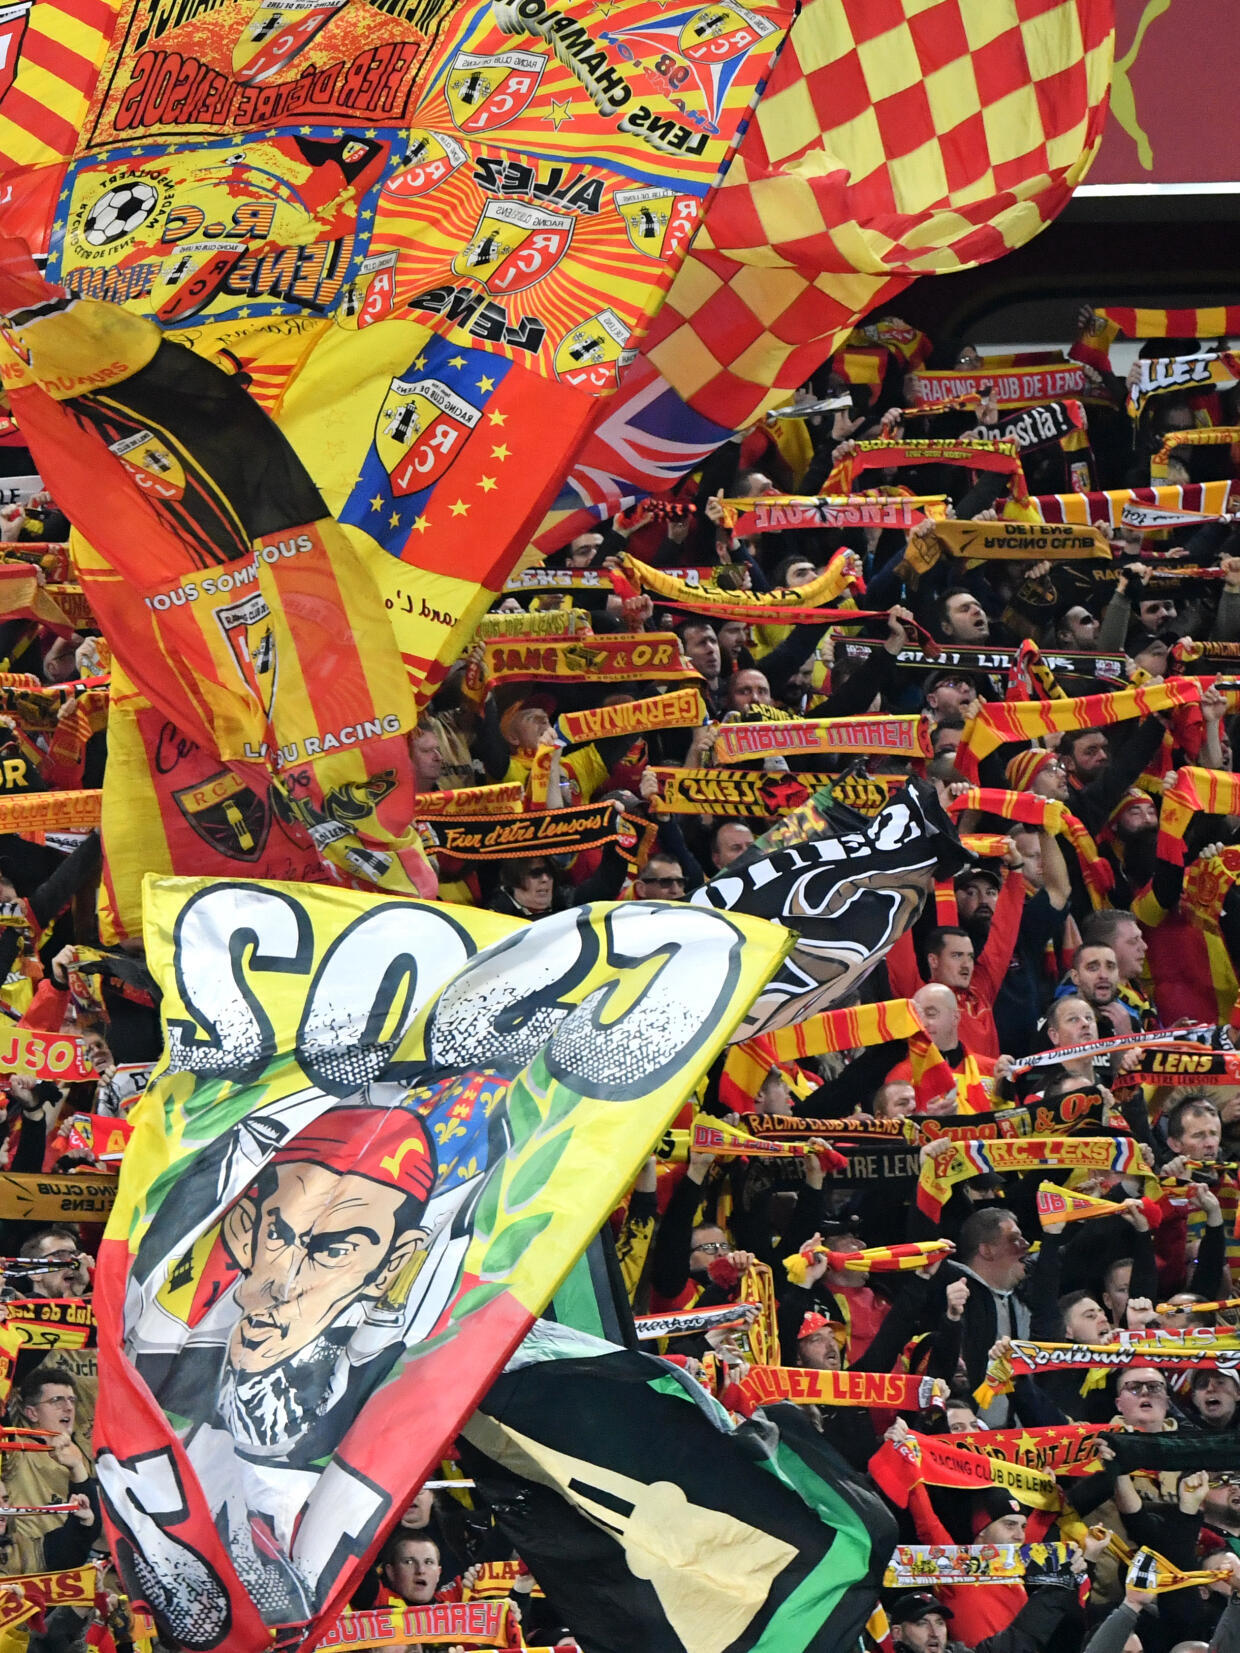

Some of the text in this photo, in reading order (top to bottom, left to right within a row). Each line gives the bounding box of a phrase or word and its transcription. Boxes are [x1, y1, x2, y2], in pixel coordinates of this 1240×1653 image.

[1024, 375, 1043, 398] DE
[1046, 371, 1084, 394] LENS
[145, 583, 200, 611] OUS
[492, 643, 673, 675] SANG & OR
[563, 697, 700, 739] GERMINAL
[304, 714, 401, 757] RACING
[719, 723, 821, 756] TRIBUNE
[12, 800, 48, 821] CLUB
[444, 828, 483, 849] Fier
[1151, 1053, 1213, 1074] LENS
[748, 1113, 807, 1132] RACING
[1035, 1105, 1056, 1133] &
[1060, 1087, 1104, 1122] Or
[694, 1124, 724, 1148] DE
[989, 1140, 1111, 1161] R.C. LENS
[739, 1367, 907, 1402] ALLEZ LENS
[929, 1451, 973, 1476] RACING
[974, 1462, 1005, 1487] CLUB
[1007, 1470, 1024, 1489] DE
[1026, 1475, 1055, 1495] LENS
